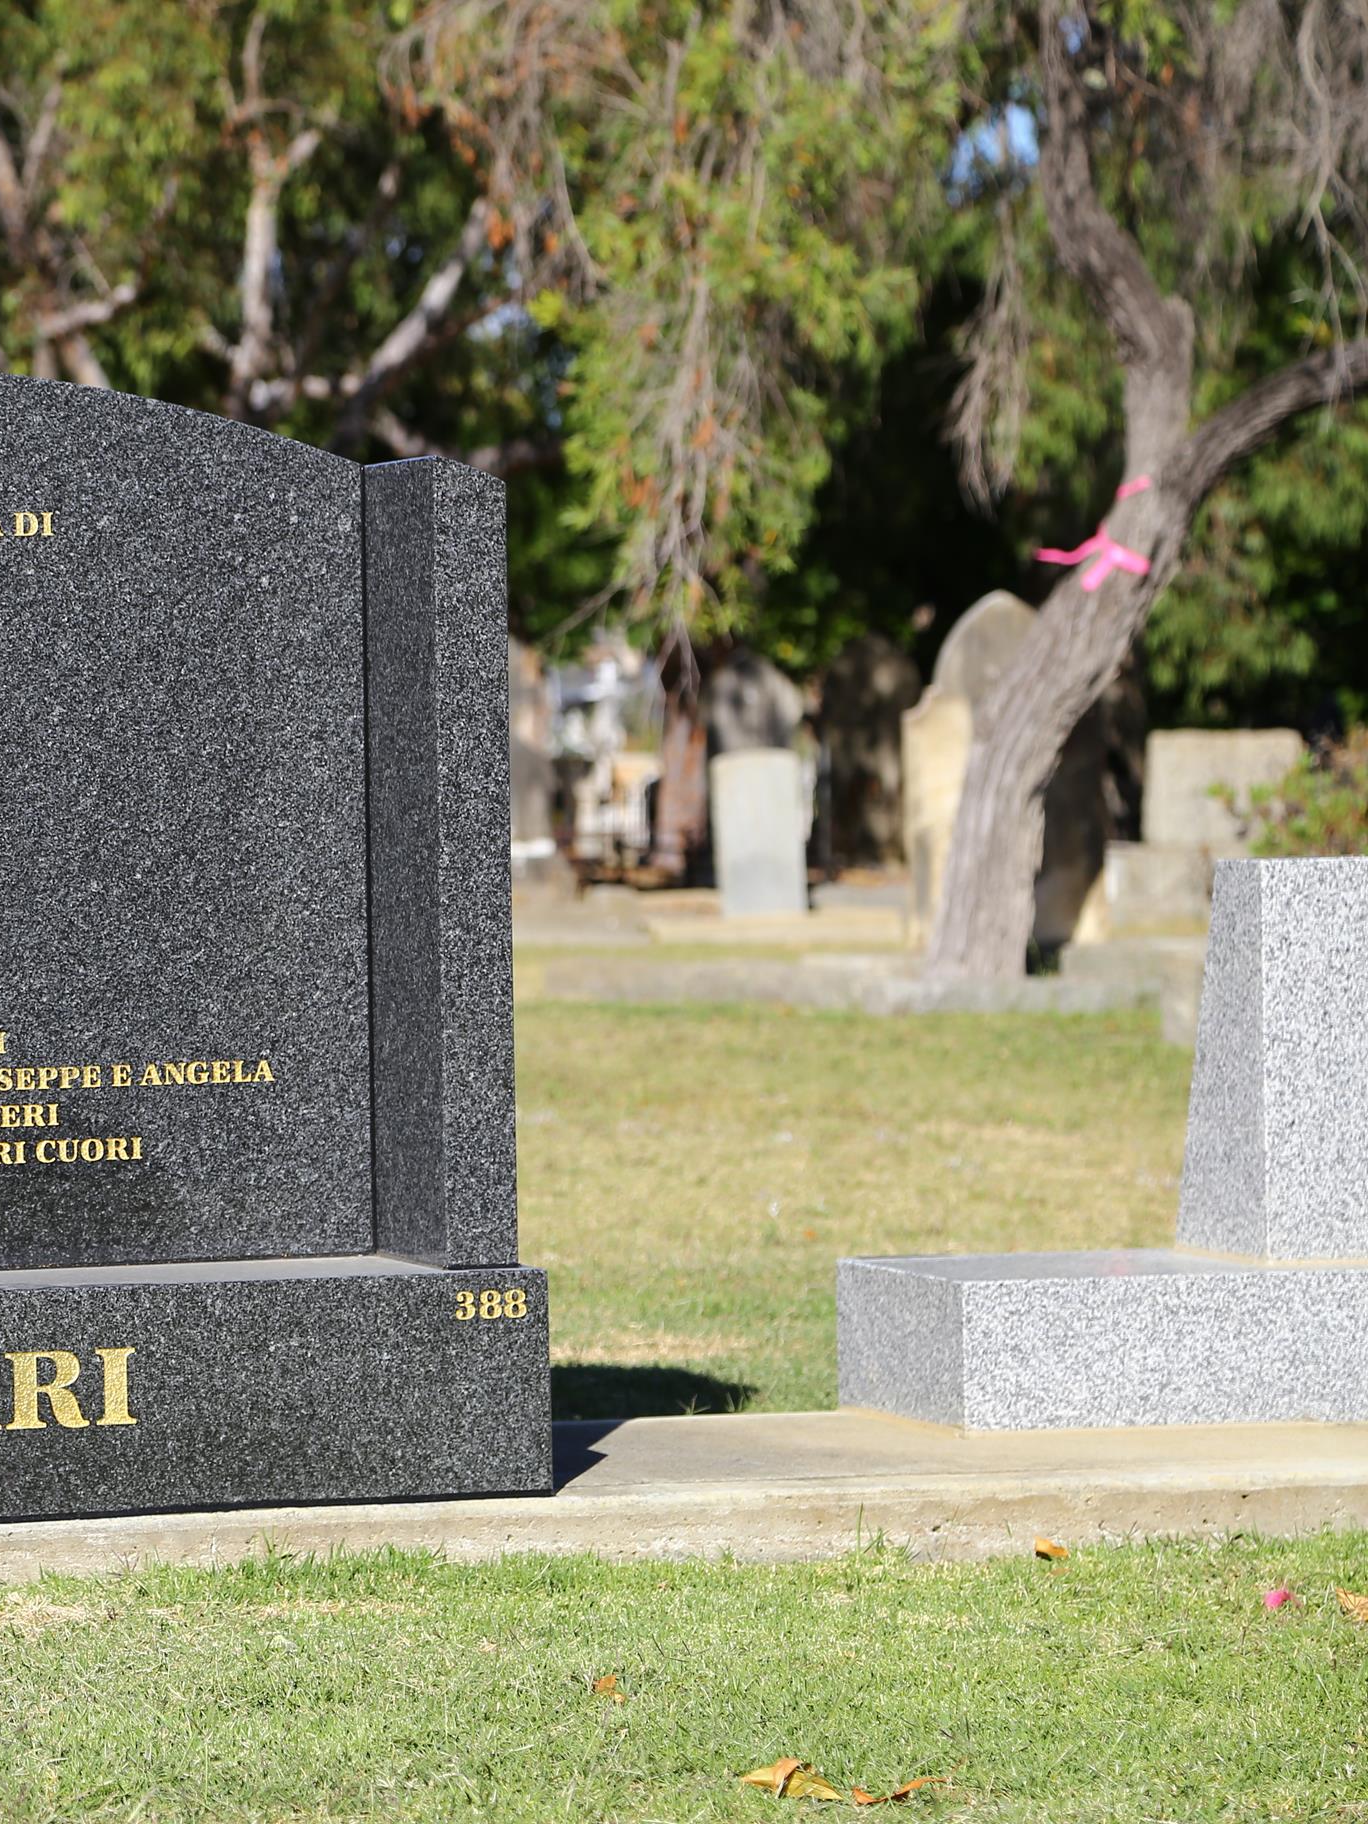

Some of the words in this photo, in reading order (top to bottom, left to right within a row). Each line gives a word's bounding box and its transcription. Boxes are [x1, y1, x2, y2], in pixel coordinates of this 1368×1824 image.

[13, 511, 53, 537] DI
[111, 1063, 132, 1088] E
[139, 1059, 275, 1086] ANGELA
[35, 1136, 144, 1164] CUORI
[455, 1287, 529, 1322] 388
